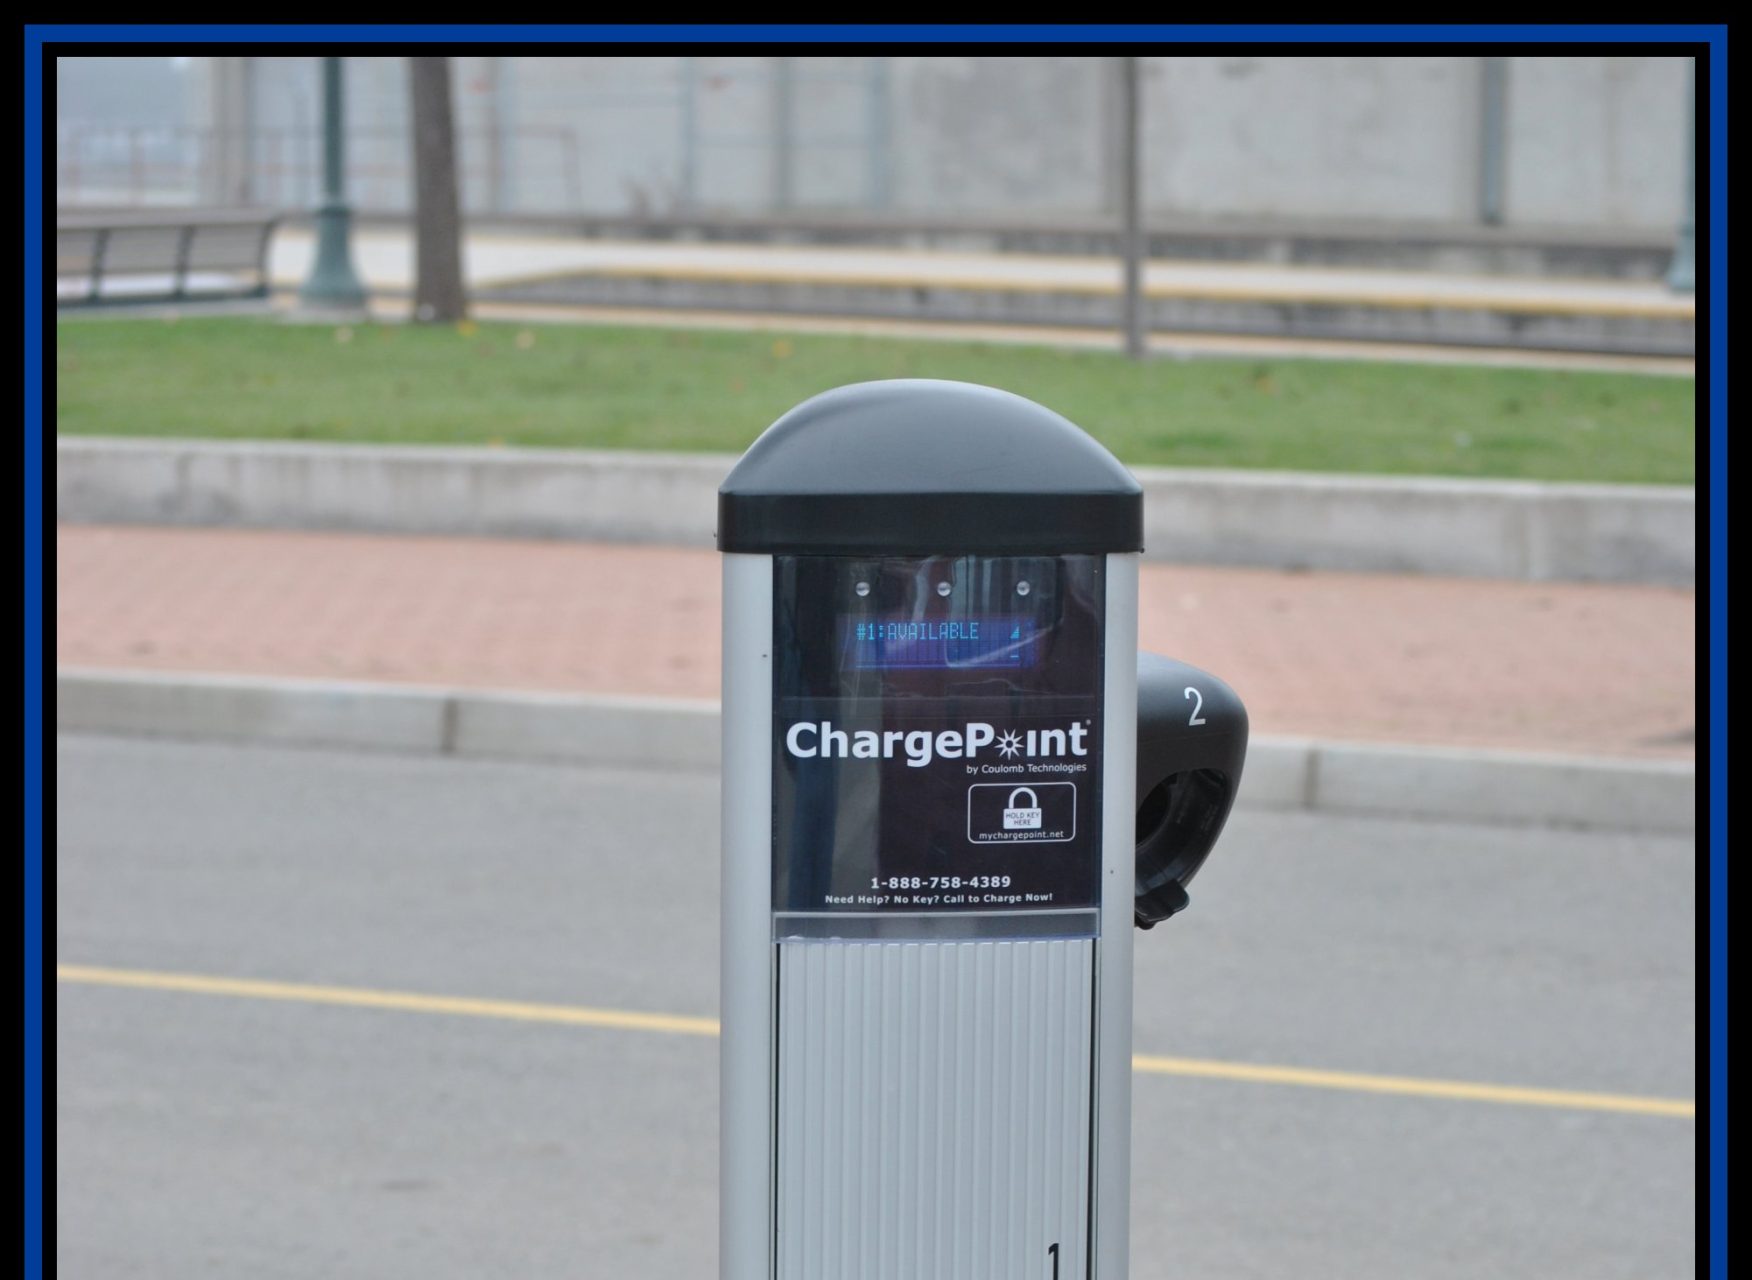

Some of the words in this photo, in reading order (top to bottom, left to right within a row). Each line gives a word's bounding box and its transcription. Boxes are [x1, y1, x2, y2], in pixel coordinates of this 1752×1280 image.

[856, 622, 979, 640] #1:AVAILABLE
[1184, 686, 1206, 726] 2
[966, 764, 979, 775] by
[981, 764, 1025, 774] Coulomb
[1027, 763, 1087, 774] Technologies
[1005, 811, 1025, 819] HOLD
[1026, 811, 1040, 819] KEY
[979, 830, 1064, 841] mychargepoint.net
[871, 876, 1011, 889] 1-888-758-4389
[825, 895, 850, 904] Need
[858, 895, 890, 905] Help?
[894, 896, 909, 904] No
[913, 895, 940, 905] Key?
[943, 894, 965, 903] Call
[968, 895, 980, 903] to
[983, 894, 1022, 904] Charge
[1025, 893, 1053, 901] Now!
